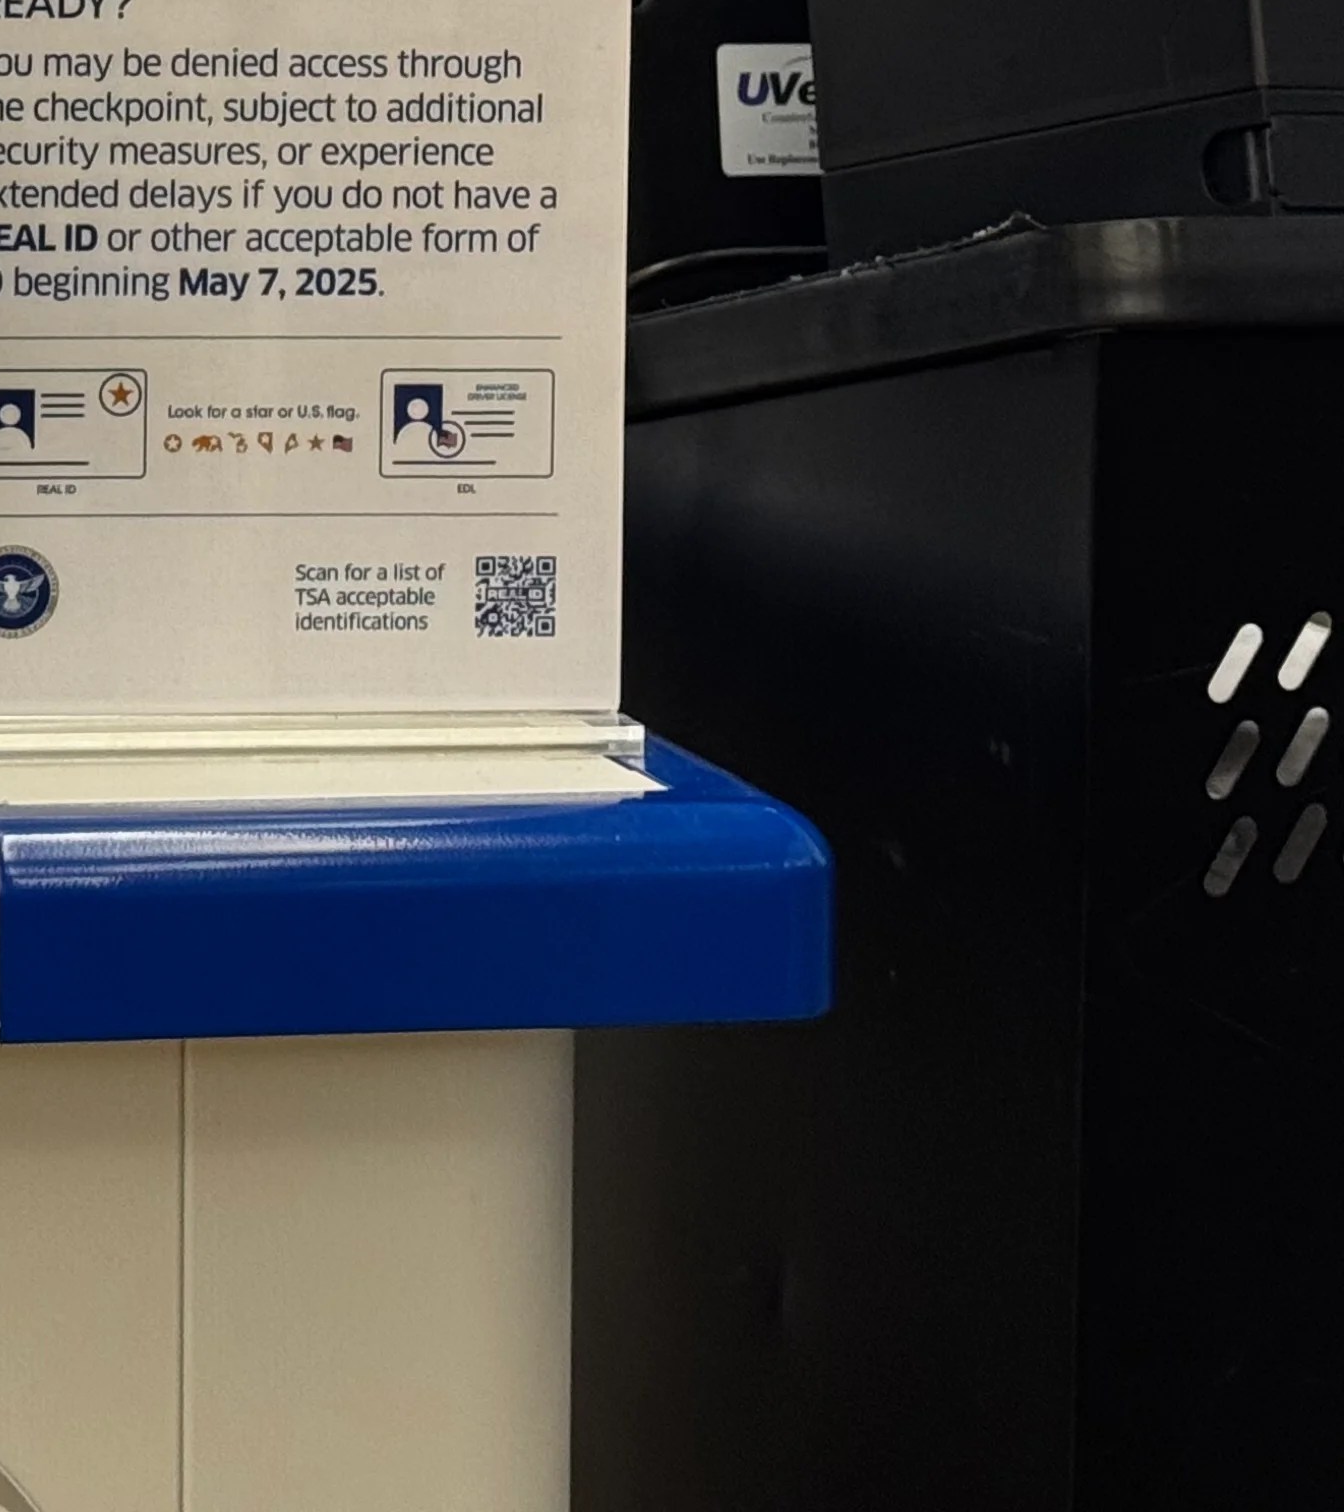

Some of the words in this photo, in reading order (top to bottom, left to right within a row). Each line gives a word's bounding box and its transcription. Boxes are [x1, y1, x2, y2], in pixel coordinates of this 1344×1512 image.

[44, 54, 113, 82] may
[124, 48, 161, 77] be
[171, 48, 278, 77] denied
[289, 55, 388, 77] access
[397, 49, 521, 83] through
[34, 91, 212, 126] checkpoint,
[224, 92, 336, 127] subject
[345, 94, 377, 122] to
[387, 92, 542, 123] additional
[110, 142, 267, 169] measures,
[278, 143, 312, 165] or
[321, 136, 494, 170] experience
[129, 179, 232, 213] delays
[244, 179, 265, 208] if
[274, 186, 332, 213] you
[343, 179, 382, 208] do
[393, 181, 444, 209] not
[455, 180, 530, 209] have
[540, 187, 557, 209] a
[65, 224, 98, 251] ID
[108, 229, 141, 252] or
[151, 222, 236, 252] other
[246, 223, 412, 257] acceptable
[422, 223, 497, 252] form
[508, 223, 541, 252] of
[15, 266, 169, 301] beginning
[180, 268, 250, 301] May
[258, 268, 285, 300] 7,
[296, 268, 384, 296] 2025.
[168, 405, 202, 418] Look
[208, 405, 227, 418] for
[231, 408, 241, 418] a
[246, 405, 274, 418] star
[277, 408, 293, 418] or
[297, 405, 324, 418] U.S.
[327, 405, 360, 422] flag.
[295, 564, 338, 582] Scan
[345, 563, 372, 581] for
[377, 567, 387, 580] a
[394, 563, 420, 581] list
[425, 563, 446, 581] of
[295, 588, 331, 606] TSA
[336, 587, 435, 608] acceptable
[296, 612, 428, 630] identifications
